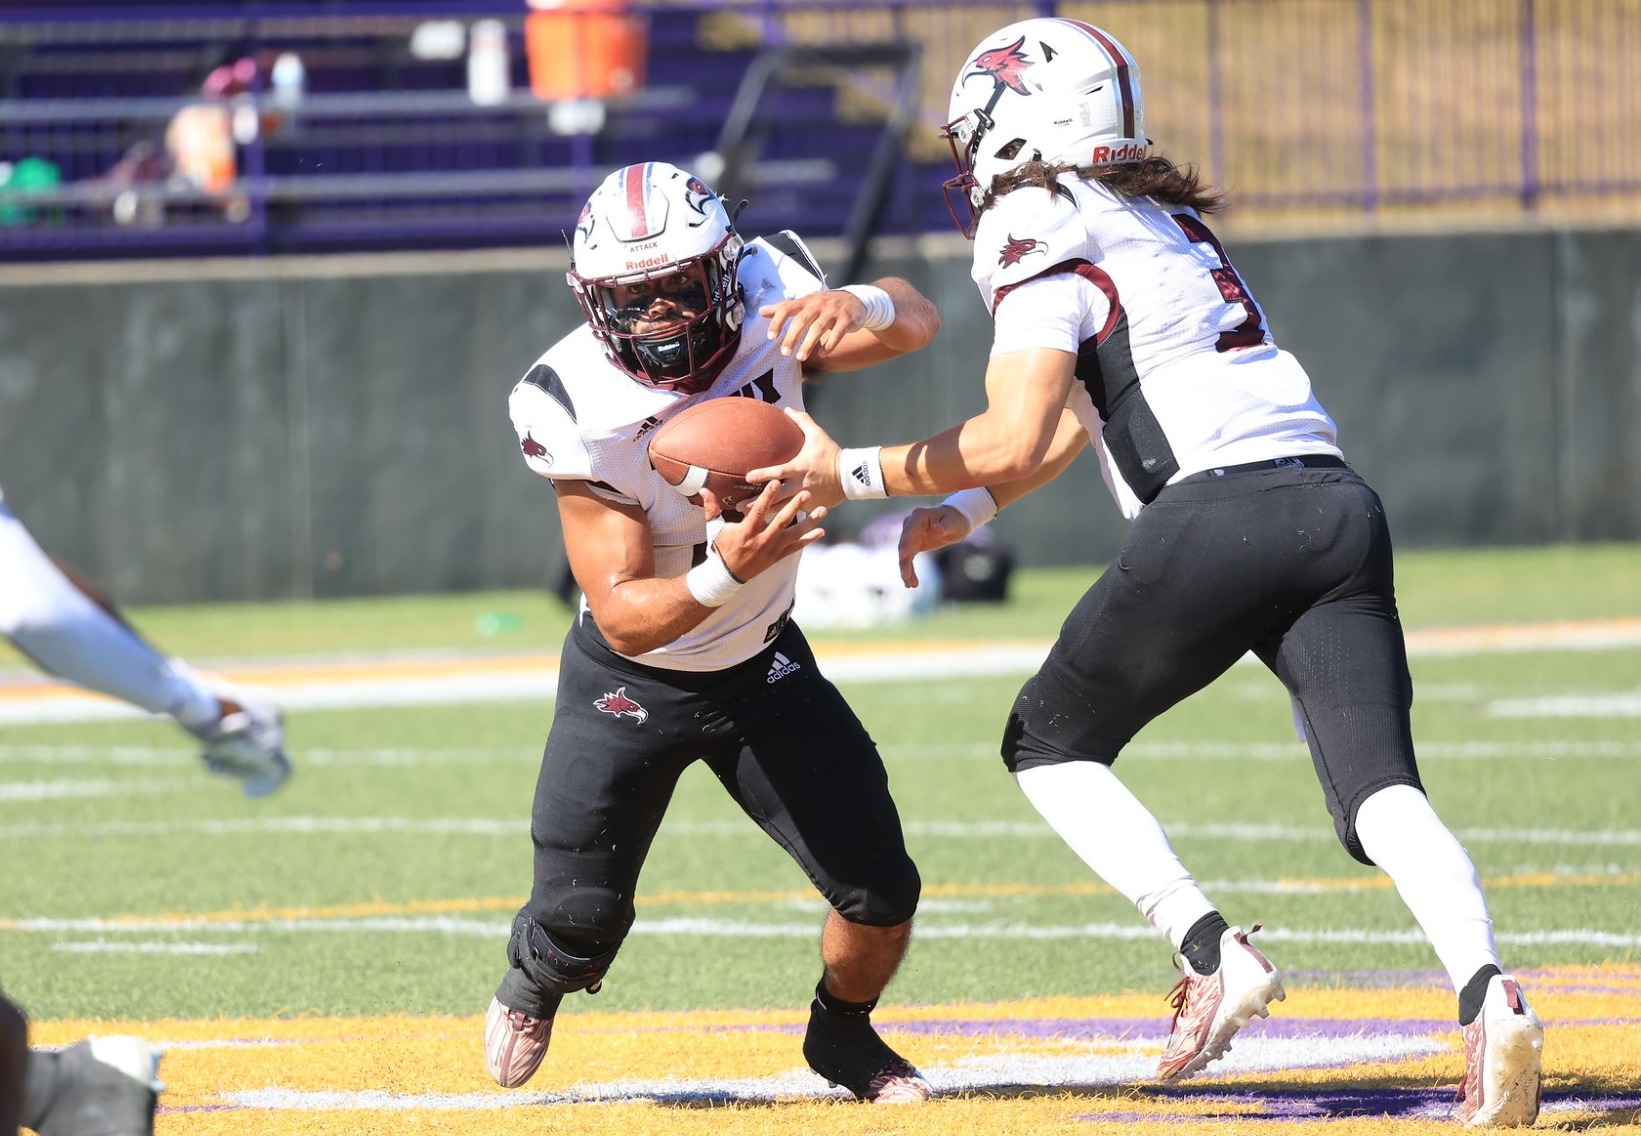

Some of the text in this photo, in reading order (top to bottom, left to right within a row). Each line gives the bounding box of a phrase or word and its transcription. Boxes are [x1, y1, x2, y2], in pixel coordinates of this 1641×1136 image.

[630, 242, 658, 253] ATTACK
[626, 253, 669, 270] Riddell
[1171, 213, 1267, 353] 3
[766, 661, 801, 684] adidas
